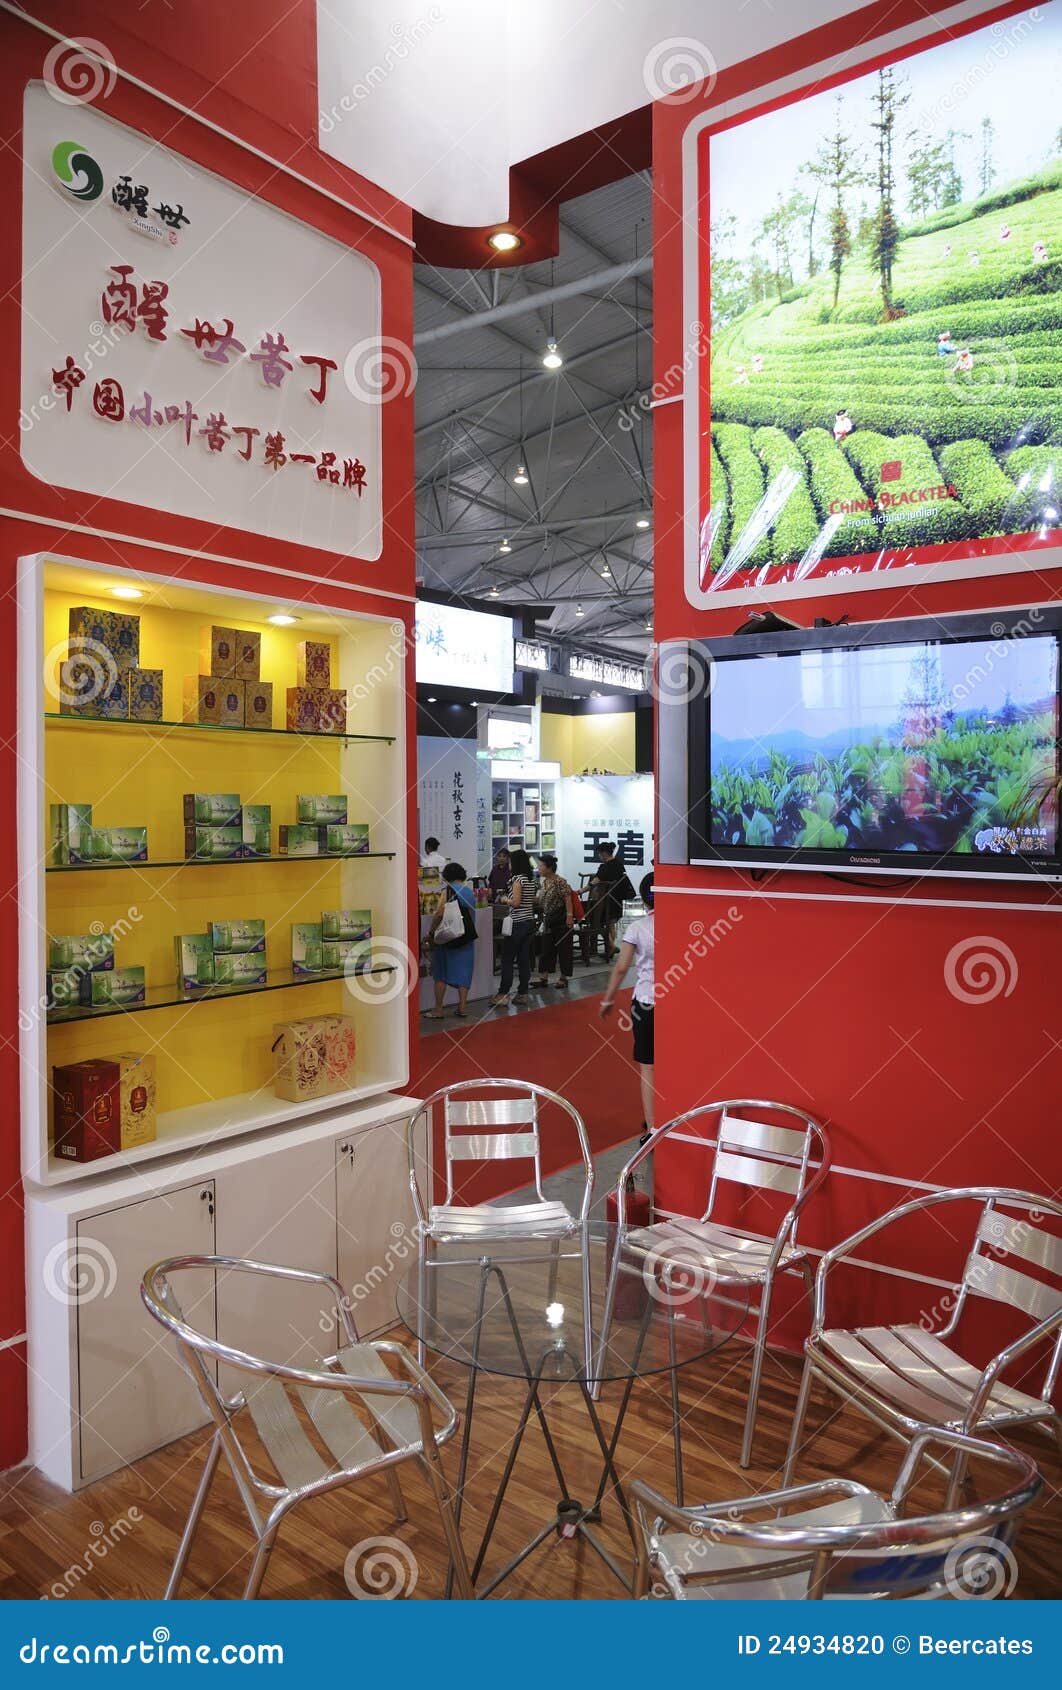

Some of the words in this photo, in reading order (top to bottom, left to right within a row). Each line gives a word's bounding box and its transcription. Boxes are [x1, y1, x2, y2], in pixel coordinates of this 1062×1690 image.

[112, 176, 190, 229] 醒世
[52, 356, 368, 498] 中国小叶苦丁第一品牌
